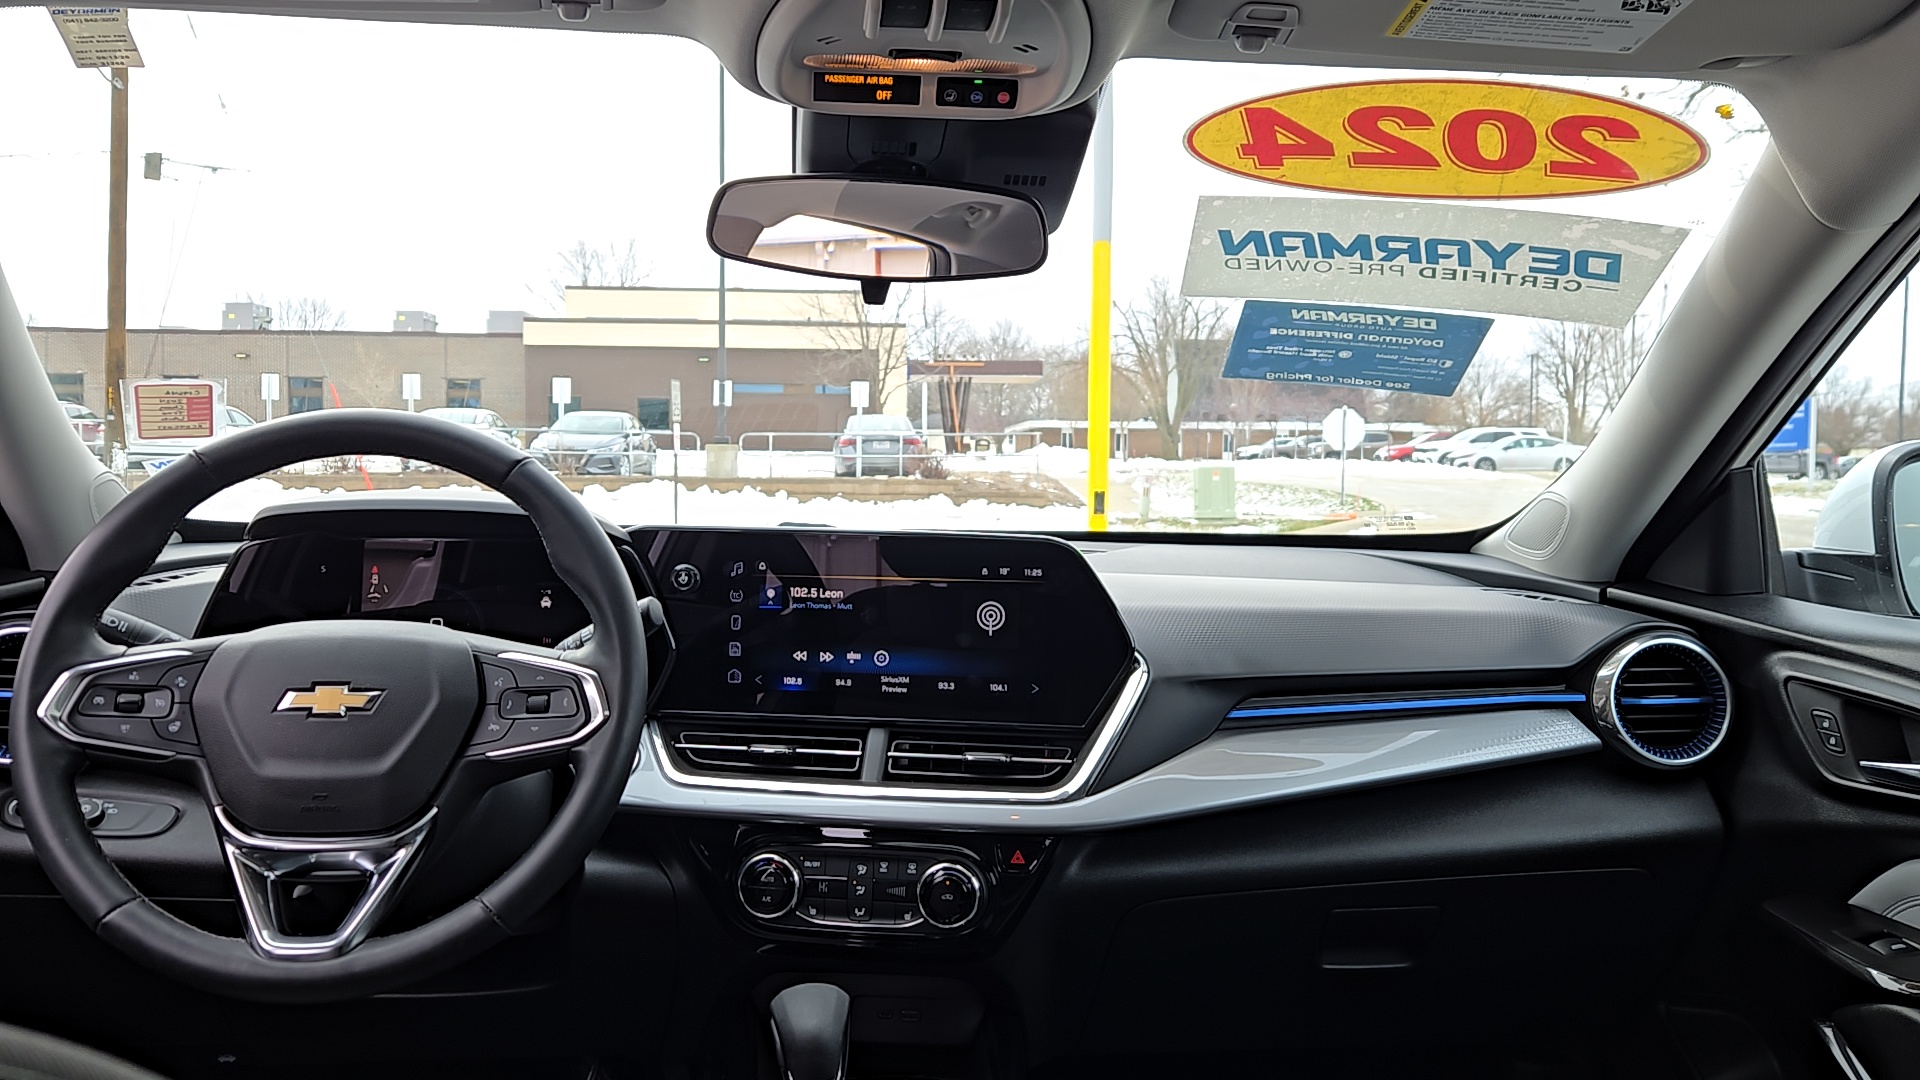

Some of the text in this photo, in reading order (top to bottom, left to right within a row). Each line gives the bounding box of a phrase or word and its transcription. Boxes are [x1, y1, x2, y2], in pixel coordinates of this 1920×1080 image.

[825, 75, 893, 85] PASSENGER AIR BAG
[876, 90, 892, 100] OFF
[1024, 568, 1043, 577] 11:25
[790, 587, 844, 599] 102.5 Leon
[806, 602, 832, 610] Thomas
[880, 675, 910, 684] SiriusXM
[989, 683, 1008, 692] 104.1
[881, 685, 908, 693] Preview
